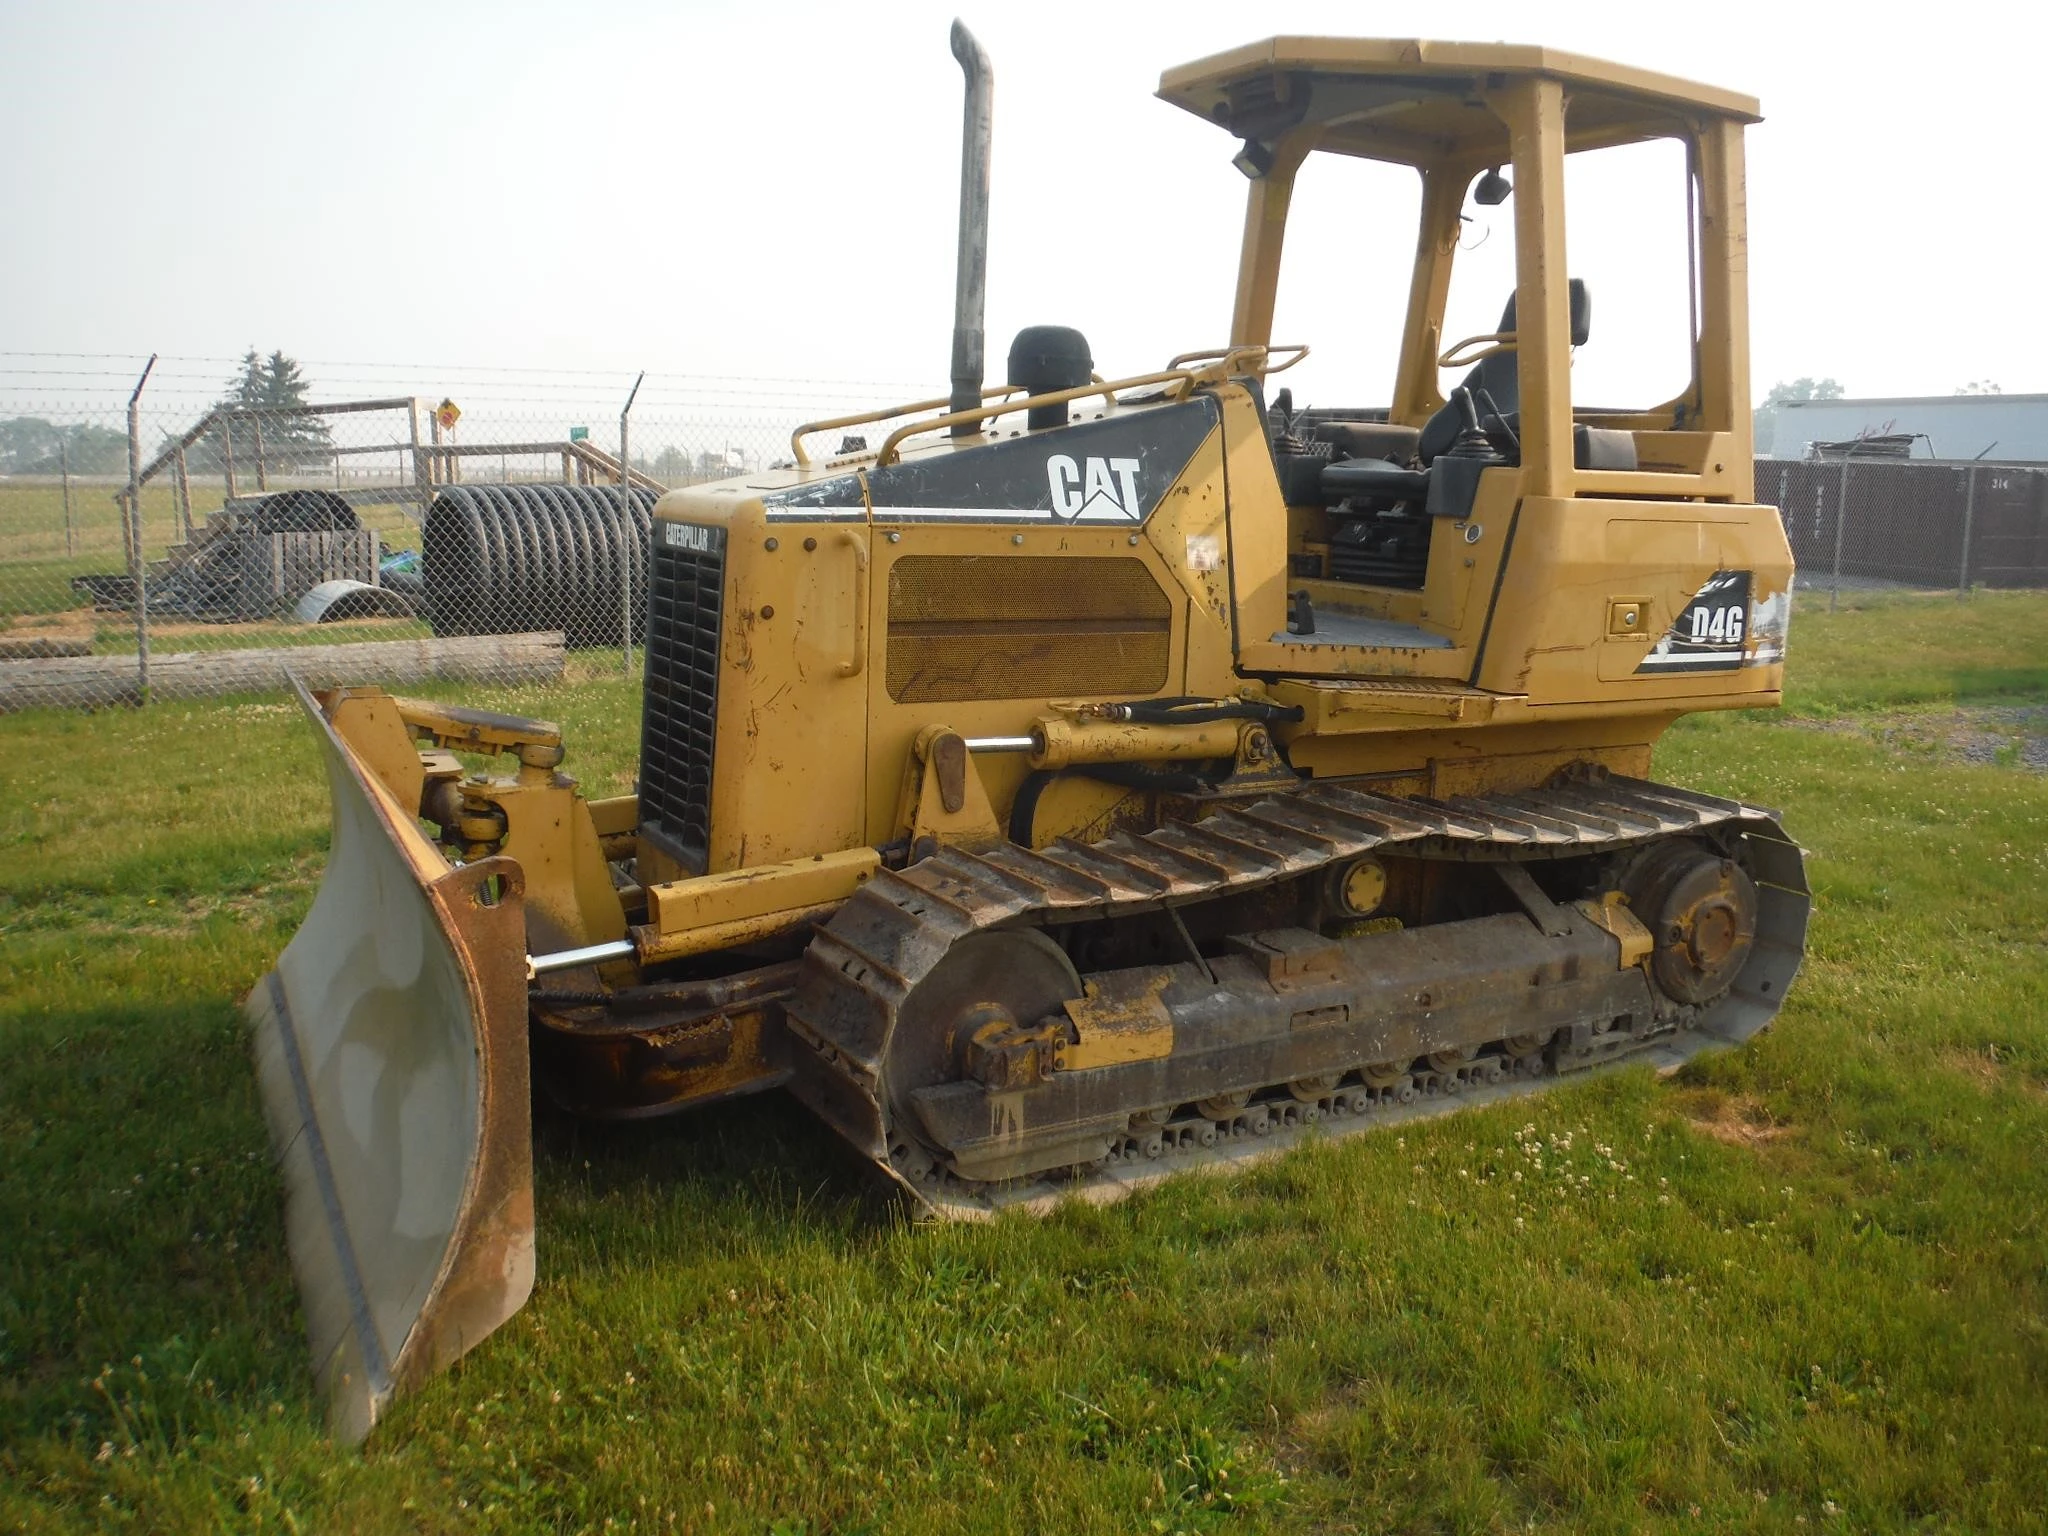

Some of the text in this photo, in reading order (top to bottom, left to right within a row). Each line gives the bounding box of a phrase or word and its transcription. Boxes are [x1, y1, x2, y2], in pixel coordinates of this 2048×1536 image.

[1047, 454, 1141, 520] CAT
[665, 522, 708, 552] CATERPILLAR
[1691, 605, 1744, 643] D4G
